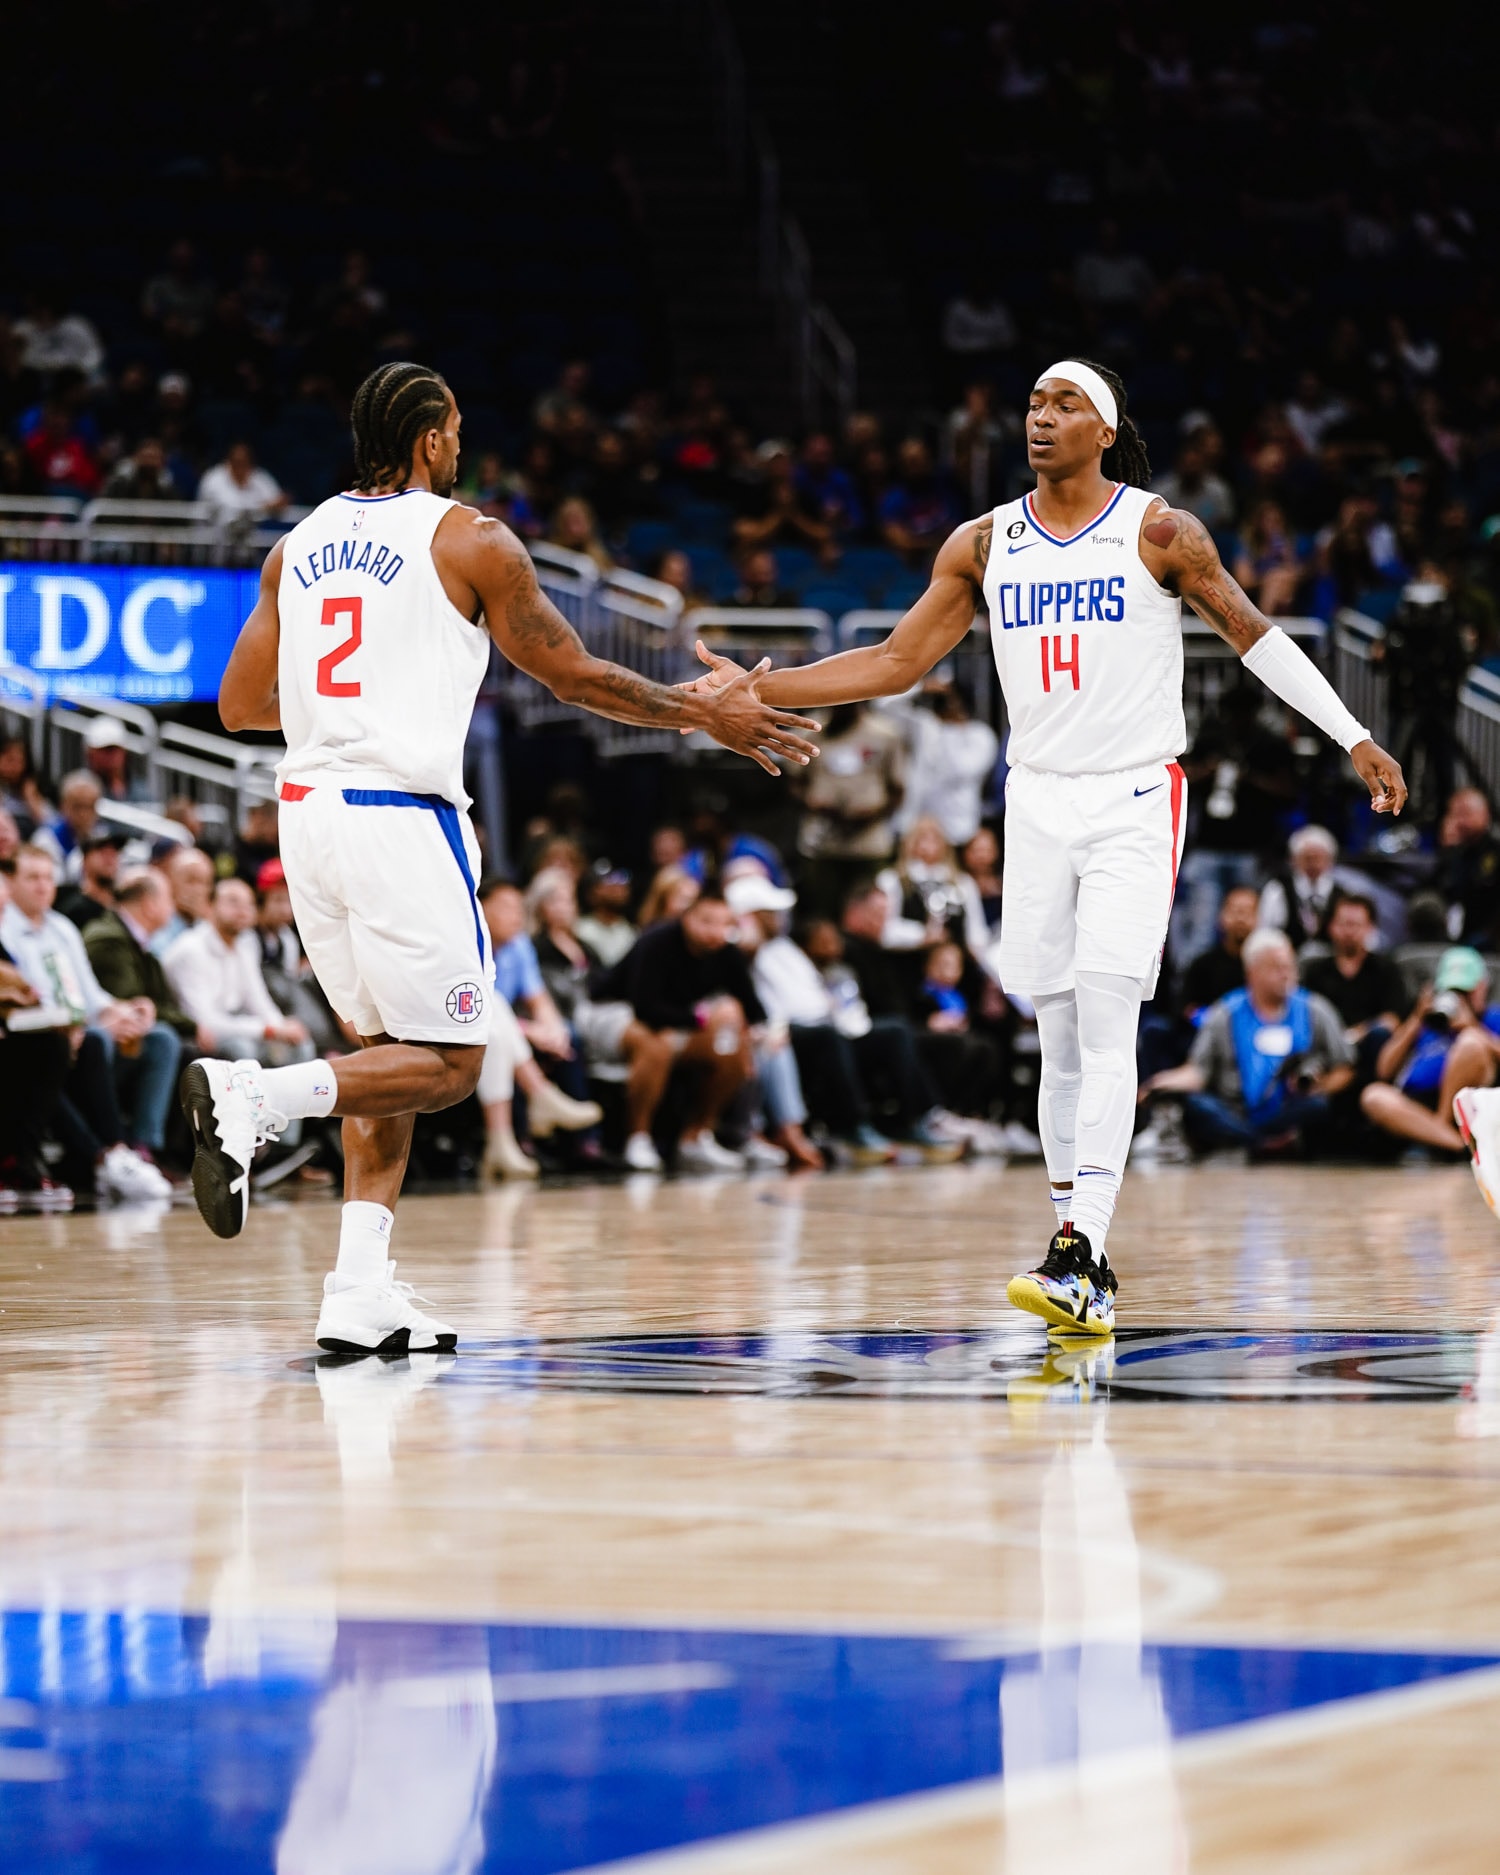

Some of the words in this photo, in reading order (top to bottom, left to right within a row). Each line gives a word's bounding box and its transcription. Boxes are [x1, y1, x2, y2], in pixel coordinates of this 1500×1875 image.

[1008, 522, 1025, 538] 6
[1091, 533, 1125, 548] honey
[293, 540, 404, 589] LEONARD
[999, 575, 1125, 629] CLIPPERS
[317, 596, 363, 697] 2
[1040, 633, 1080, 692] 14
